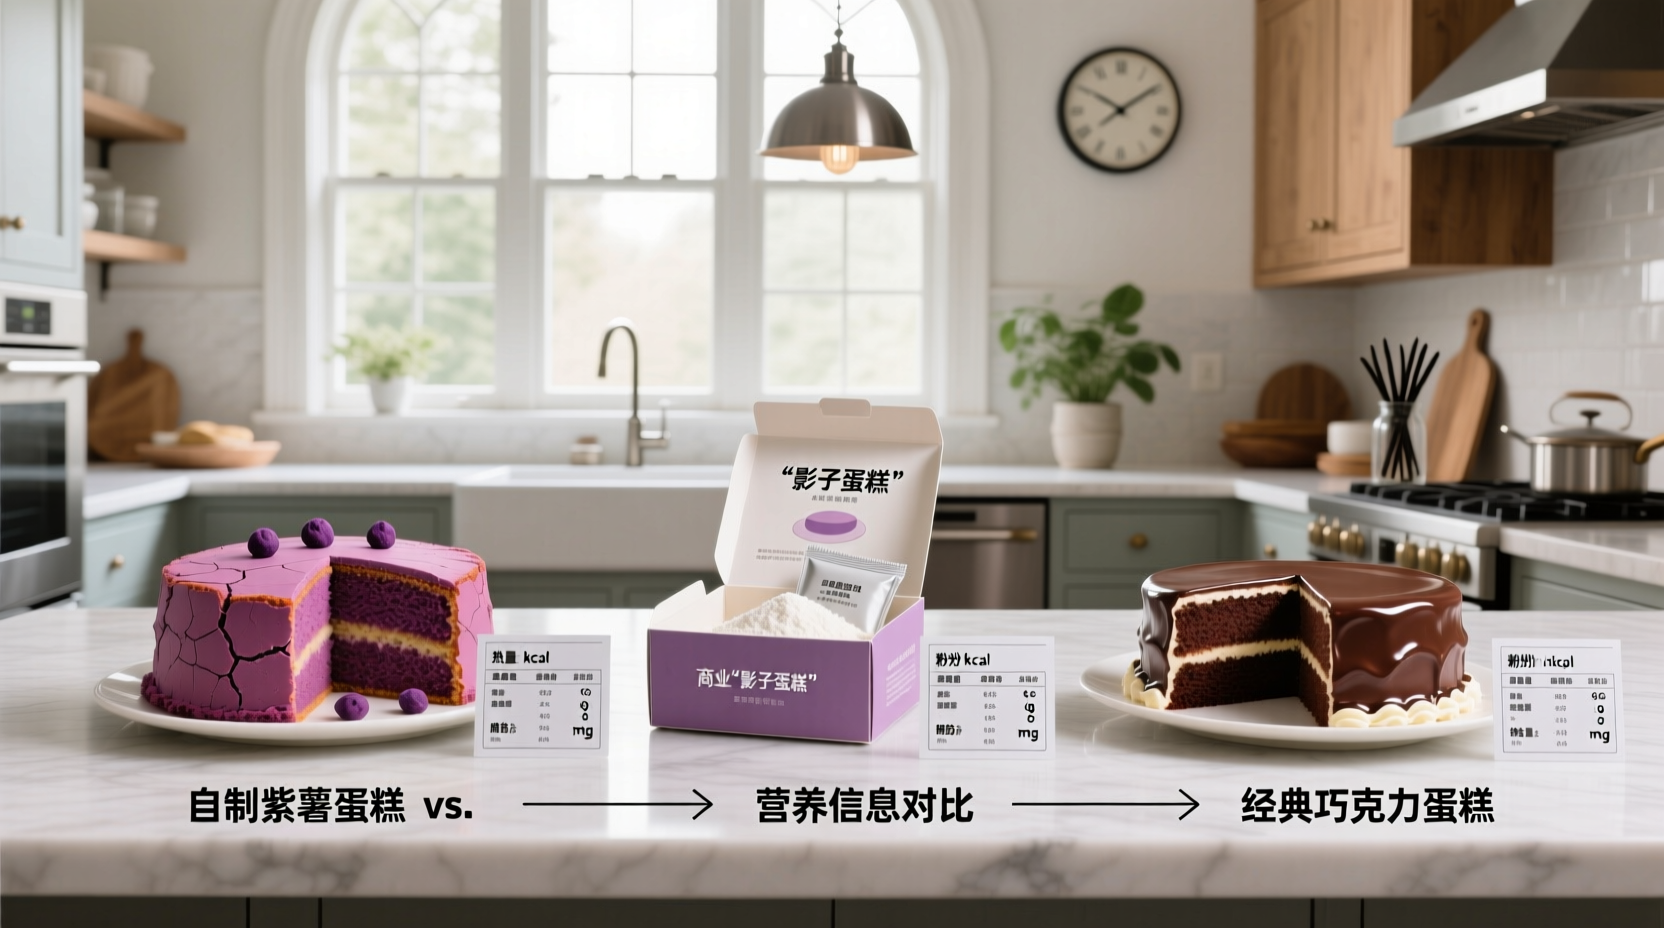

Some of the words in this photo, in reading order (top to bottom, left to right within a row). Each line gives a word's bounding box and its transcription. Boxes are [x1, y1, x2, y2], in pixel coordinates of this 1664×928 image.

[782, 466, 904, 494] “影子蛋糕”
[524, 650, 550, 664] kcal
[964, 653, 990, 666] kcal
[572, 726, 594, 740] mg
[1018, 729, 1039, 742] mg
[1589, 730, 1610, 744] mg
